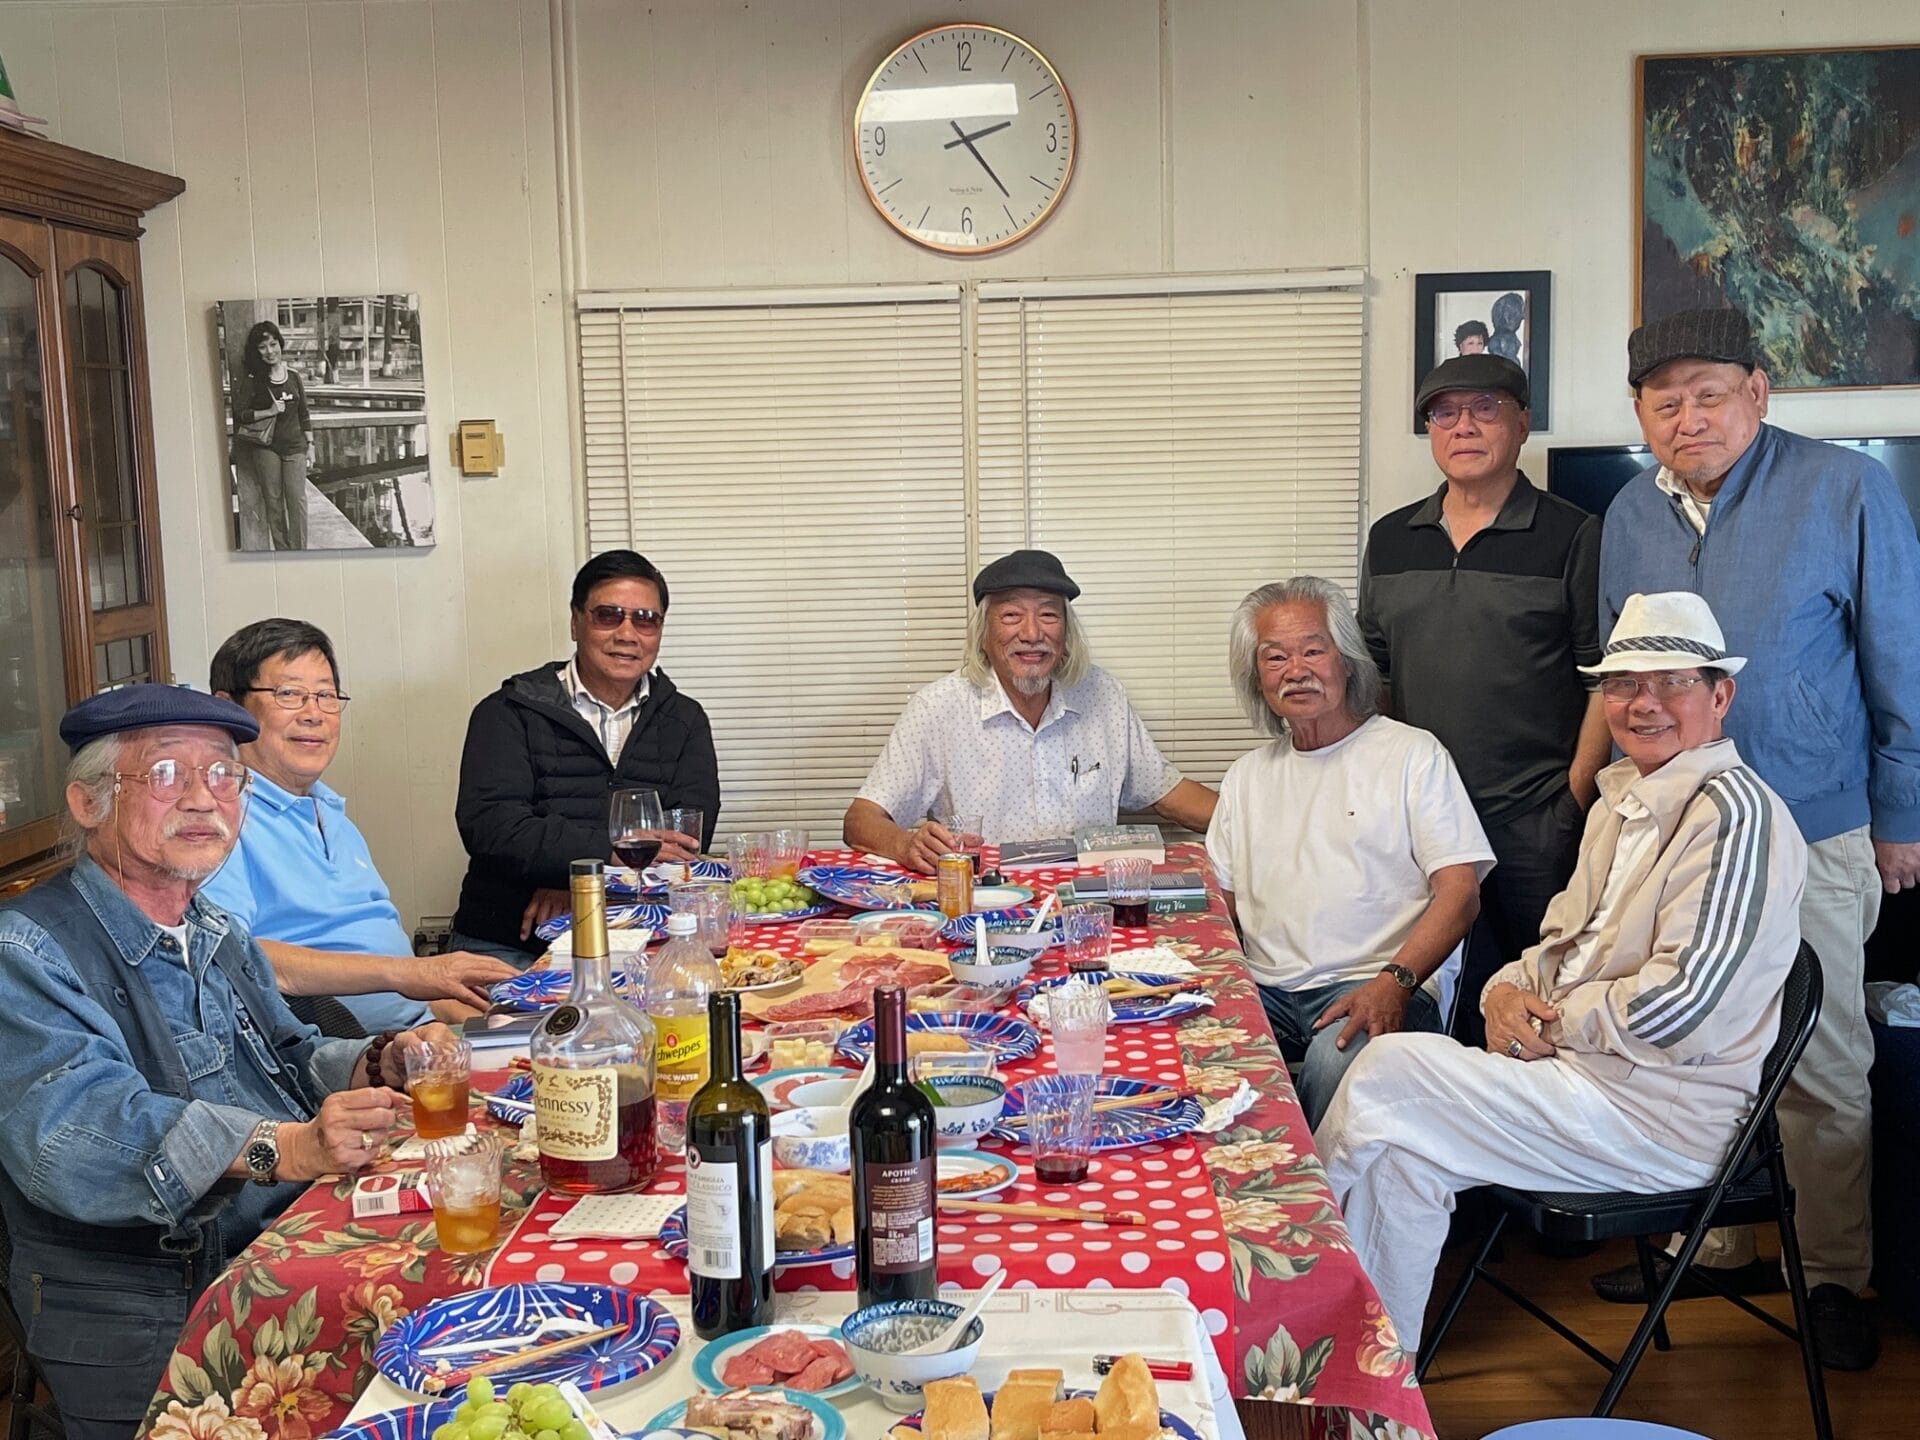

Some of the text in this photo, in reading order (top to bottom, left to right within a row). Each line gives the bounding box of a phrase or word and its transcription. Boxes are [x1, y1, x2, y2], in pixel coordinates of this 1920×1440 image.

[957, 41, 972, 71] 12
[874, 126, 886, 156] 9
[1046, 122, 1057, 153] 3
[961, 206, 973, 234] 6
[656, 1040, 701, 1062] chweppes
[672, 1073, 699, 1081] WATER
[882, 1167, 919, 1178] APOTHIC
